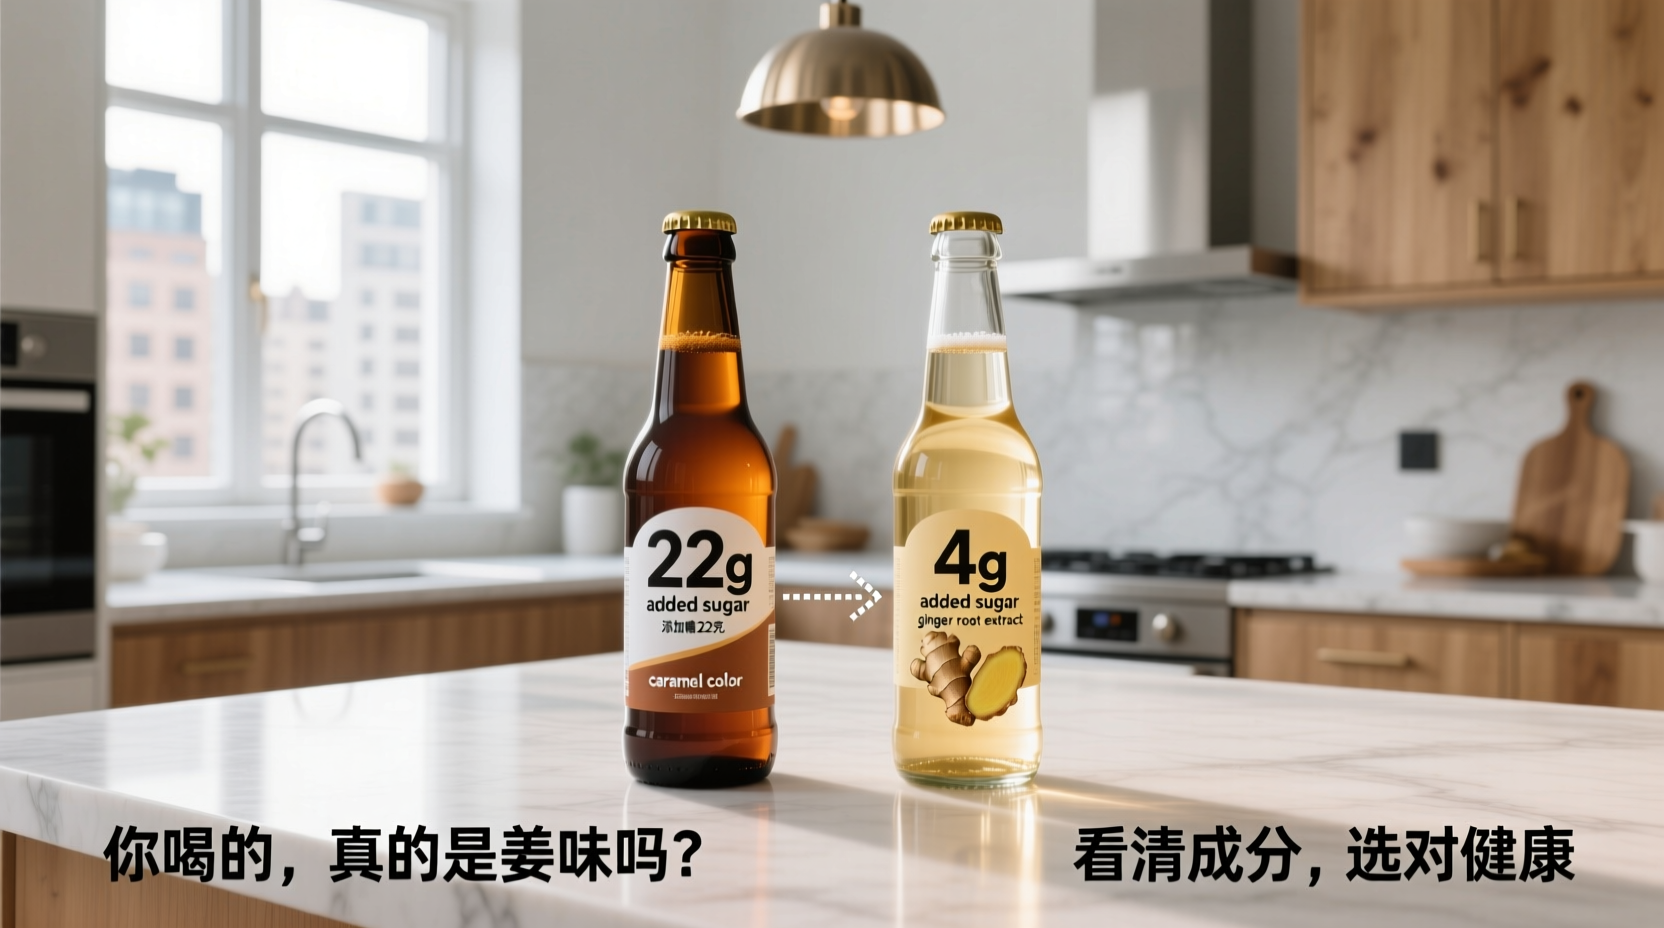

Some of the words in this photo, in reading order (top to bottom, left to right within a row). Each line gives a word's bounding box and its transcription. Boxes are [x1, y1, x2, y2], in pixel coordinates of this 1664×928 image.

[647, 529, 753, 596] 22g
[933, 529, 1007, 593] 4g
[646, 595, 698, 612] added
[702, 600, 750, 616] sugar
[920, 593, 971, 609] added
[975, 597, 1020, 613] sugar
[917, 614, 953, 629] ginger
[956, 615, 982, 626] root
[984, 613, 1024, 626] extract
[648, 673, 703, 688] caramel
[706, 672, 744, 687] color
